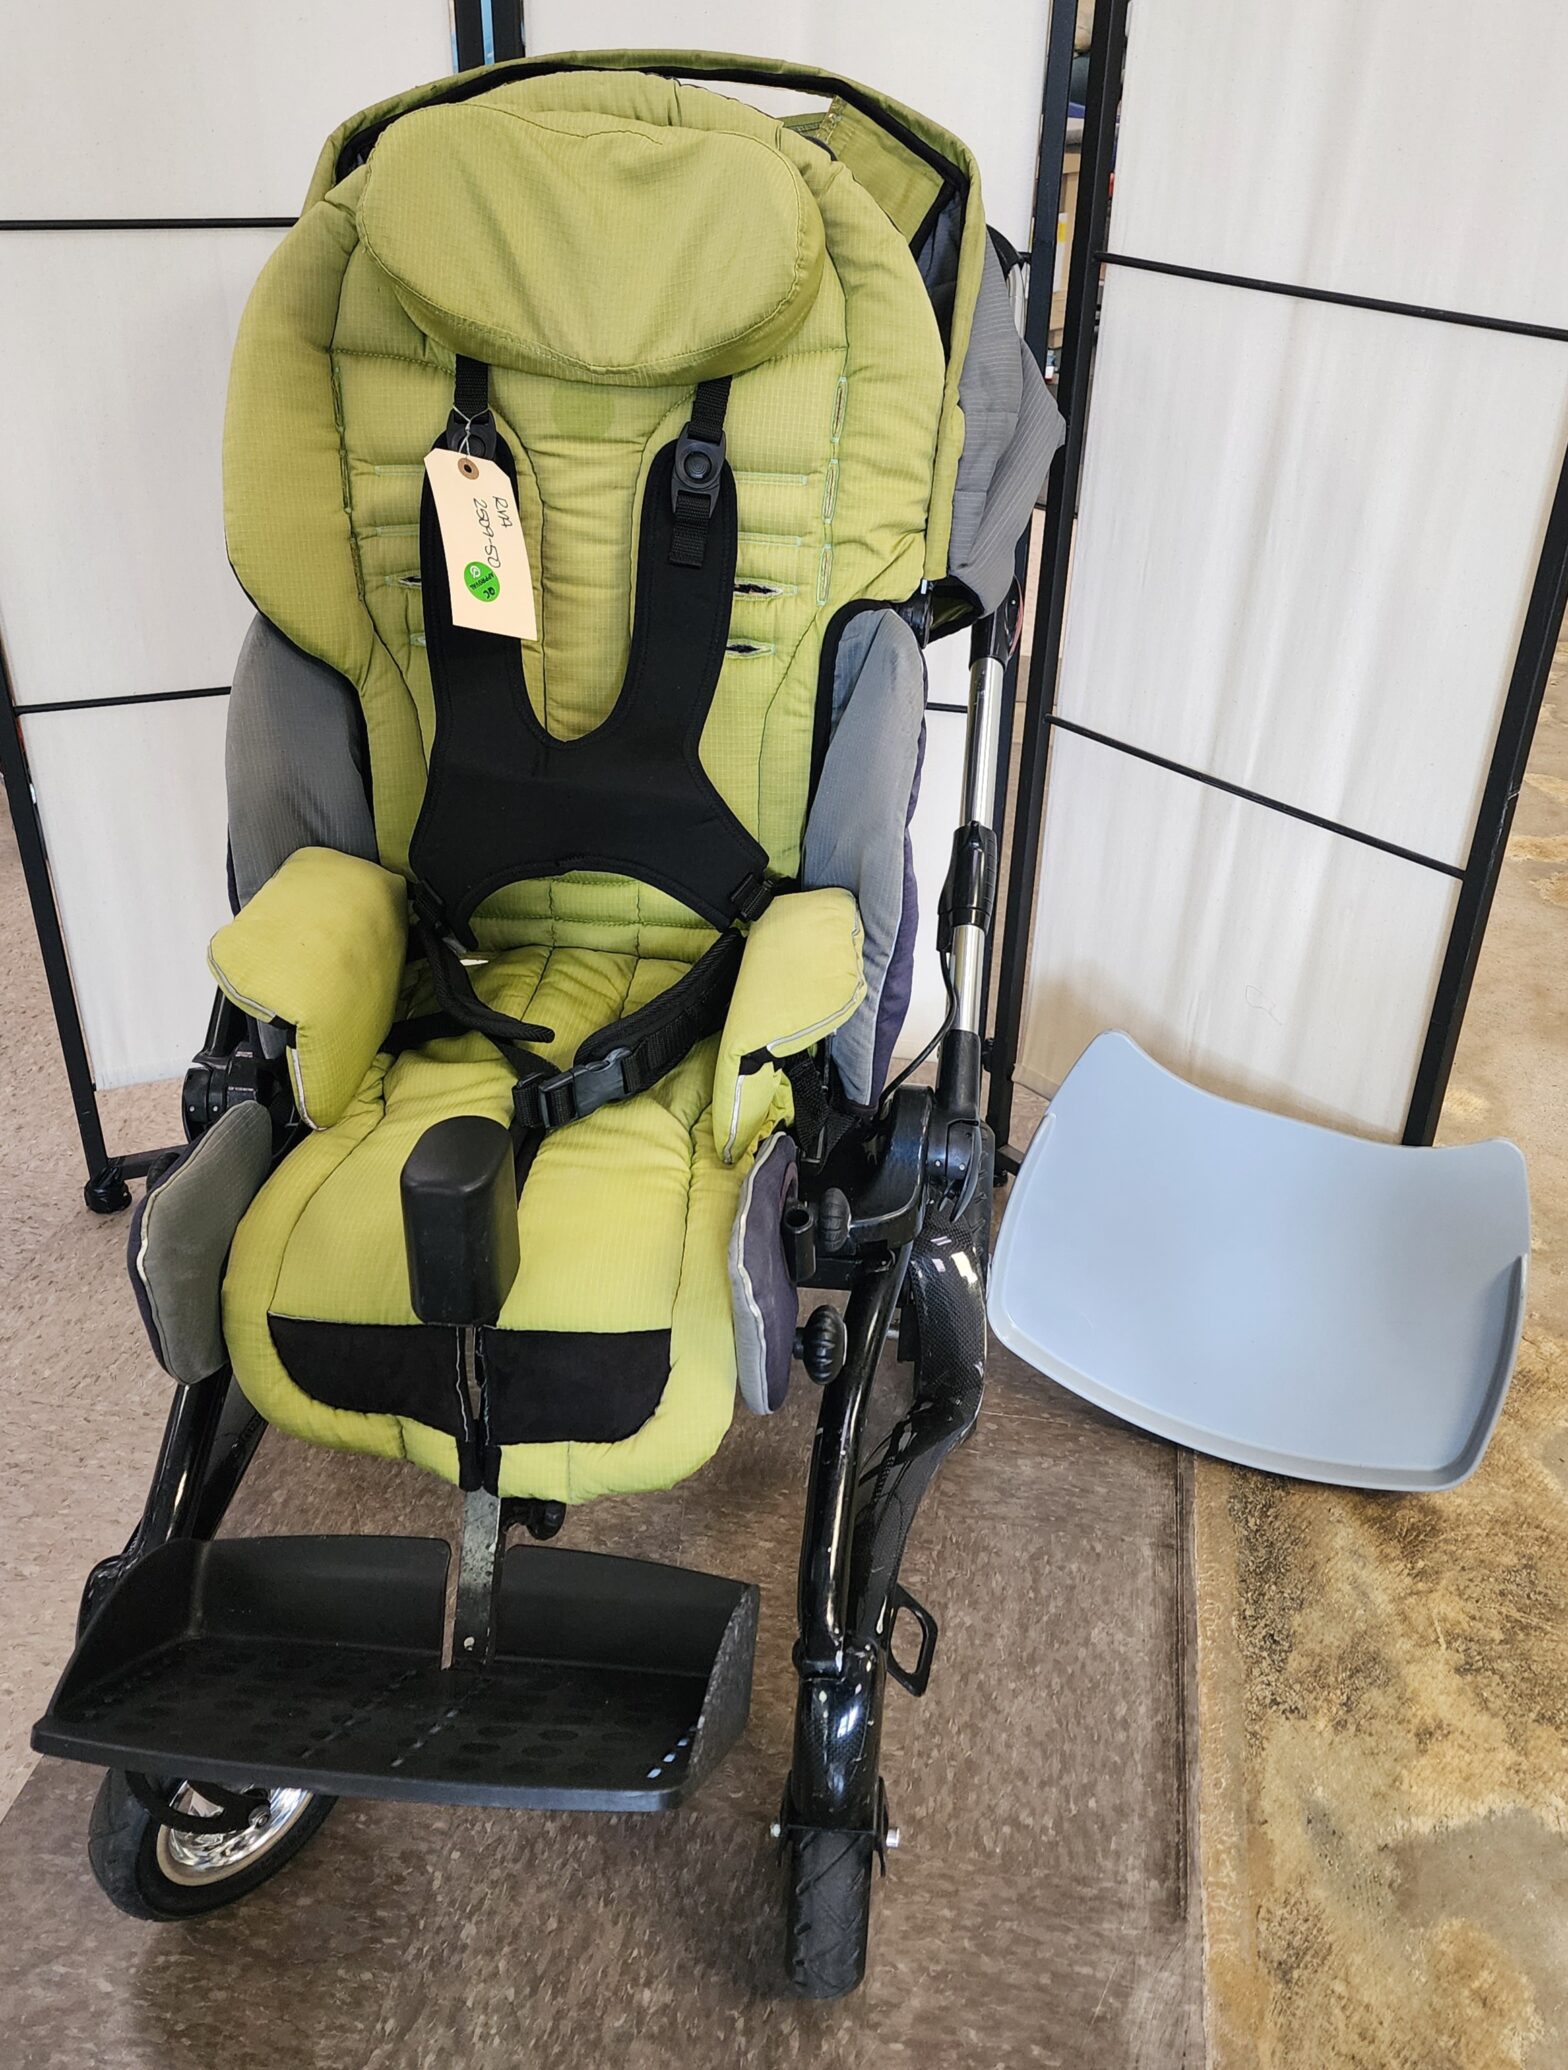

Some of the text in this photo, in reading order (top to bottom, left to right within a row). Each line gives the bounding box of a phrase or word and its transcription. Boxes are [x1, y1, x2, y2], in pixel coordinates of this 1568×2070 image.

[492, 496, 512, 528] RVA
[473, 498, 501, 568] 2509-50
[483, 587, 495, 599] QC
